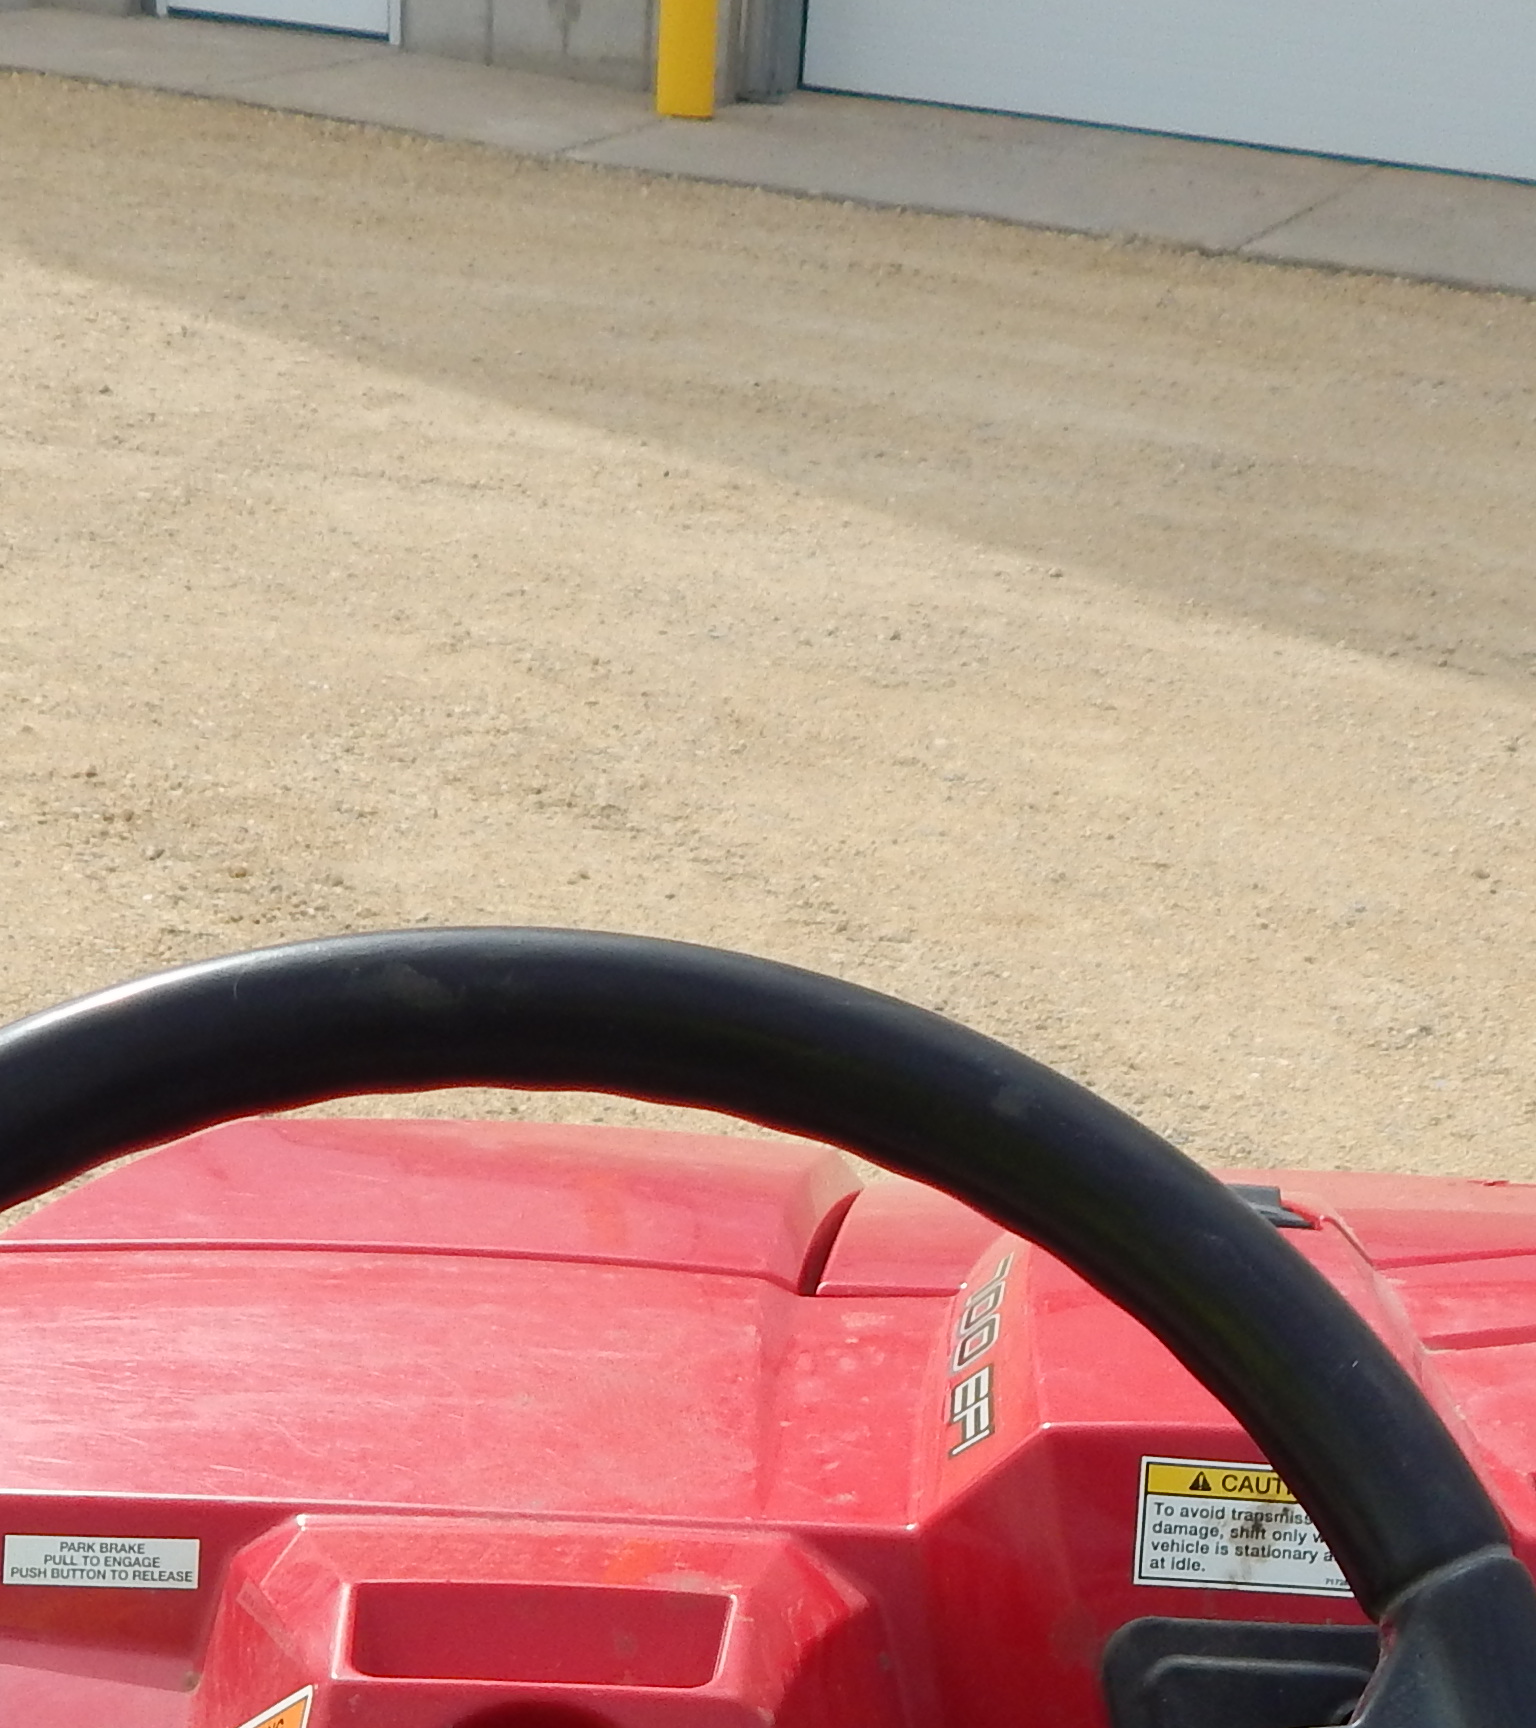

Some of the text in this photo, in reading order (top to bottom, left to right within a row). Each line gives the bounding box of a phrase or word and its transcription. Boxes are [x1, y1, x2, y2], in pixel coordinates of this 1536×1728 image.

[949, 1363, 996, 1459] EFI
[1154, 1502, 1174, 1517] To
[1180, 1506, 1225, 1520] avoid
[1152, 1521, 1224, 1540] damage,
[1230, 1527, 1267, 1540] shift
[1272, 1530, 1308, 1545] only
[60, 1541, 146, 1555] PARK BRAKE
[1151, 1539, 1209, 1555] vehicle
[1214, 1543, 1229, 1556] is
[1234, 1544, 1318, 1565] stationary
[43, 1554, 161, 1569] PULL TO ENGAGE
[1149, 1557, 1206, 1572] at idle.
[10, 1567, 194, 1582] PUSH BUTTON TO RELEASE
